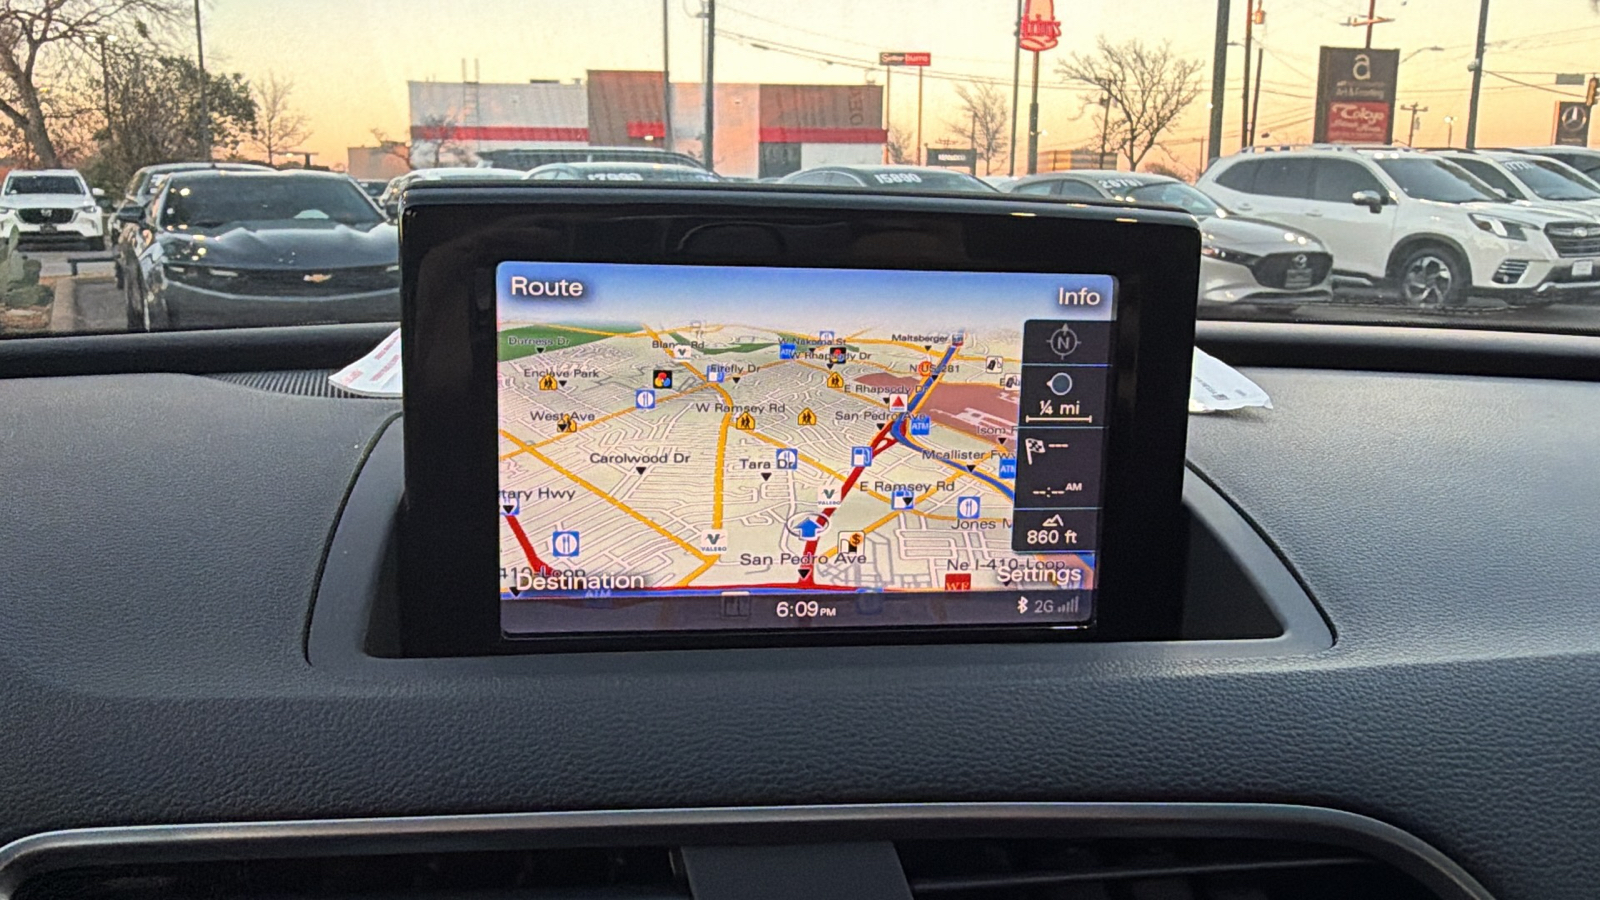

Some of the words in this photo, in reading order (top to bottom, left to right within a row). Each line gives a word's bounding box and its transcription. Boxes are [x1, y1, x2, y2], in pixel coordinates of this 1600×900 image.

[511, 276, 584, 298] Route
[1058, 287, 1101, 306] Info
[891, 334, 949, 343] Maltsberger
[1057, 335, 1070, 349] N
[691, 341, 704, 349] Rd
[859, 352, 872, 360] Dr
[574, 369, 599, 378] Park
[748, 364, 761, 373] Dr
[910, 364, 917, 372] N
[844, 384, 851, 393] E
[856, 384, 911, 394] Rhapsody
[696, 404, 710, 413] W
[715, 404, 765, 416] Ramsey
[769, 404, 786, 413] Rd
[1060, 401, 1080, 415] mi
[530, 411, 565, 421] West
[570, 411, 595, 421] Ave
[835, 411, 859, 420] San
[864, 411, 898, 421] Pedro
[977, 425, 1006, 435] Isom
[590, 453, 668, 464] Carolwood
[674, 454, 691, 463] Dr
[922, 449, 985, 460] Mcallister
[739, 459, 771, 469] Tara
[777, 459, 794, 469] Dr
[860, 482, 868, 491] E
[874, 481, 931, 493] Ramsey
[936, 482, 955, 491] Rd
[1065, 482, 1083, 491] AM
[538, 487, 576, 501] Hwy
[951, 518, 996, 529] Jones
[1027, 530, 1059, 544] 860
[1064, 531, 1078, 544] ft
[740, 553, 773, 565] San
[780, 552, 828, 565] Pedro
[834, 552, 867, 564] Ave
[947, 559, 969, 571] Ne
[997, 565, 1082, 586] Settings
[516, 573, 645, 590] Destination
[776, 601, 819, 617] 6:09
[820, 607, 837, 616] PM
[1034, 600, 1054, 613] 2G
